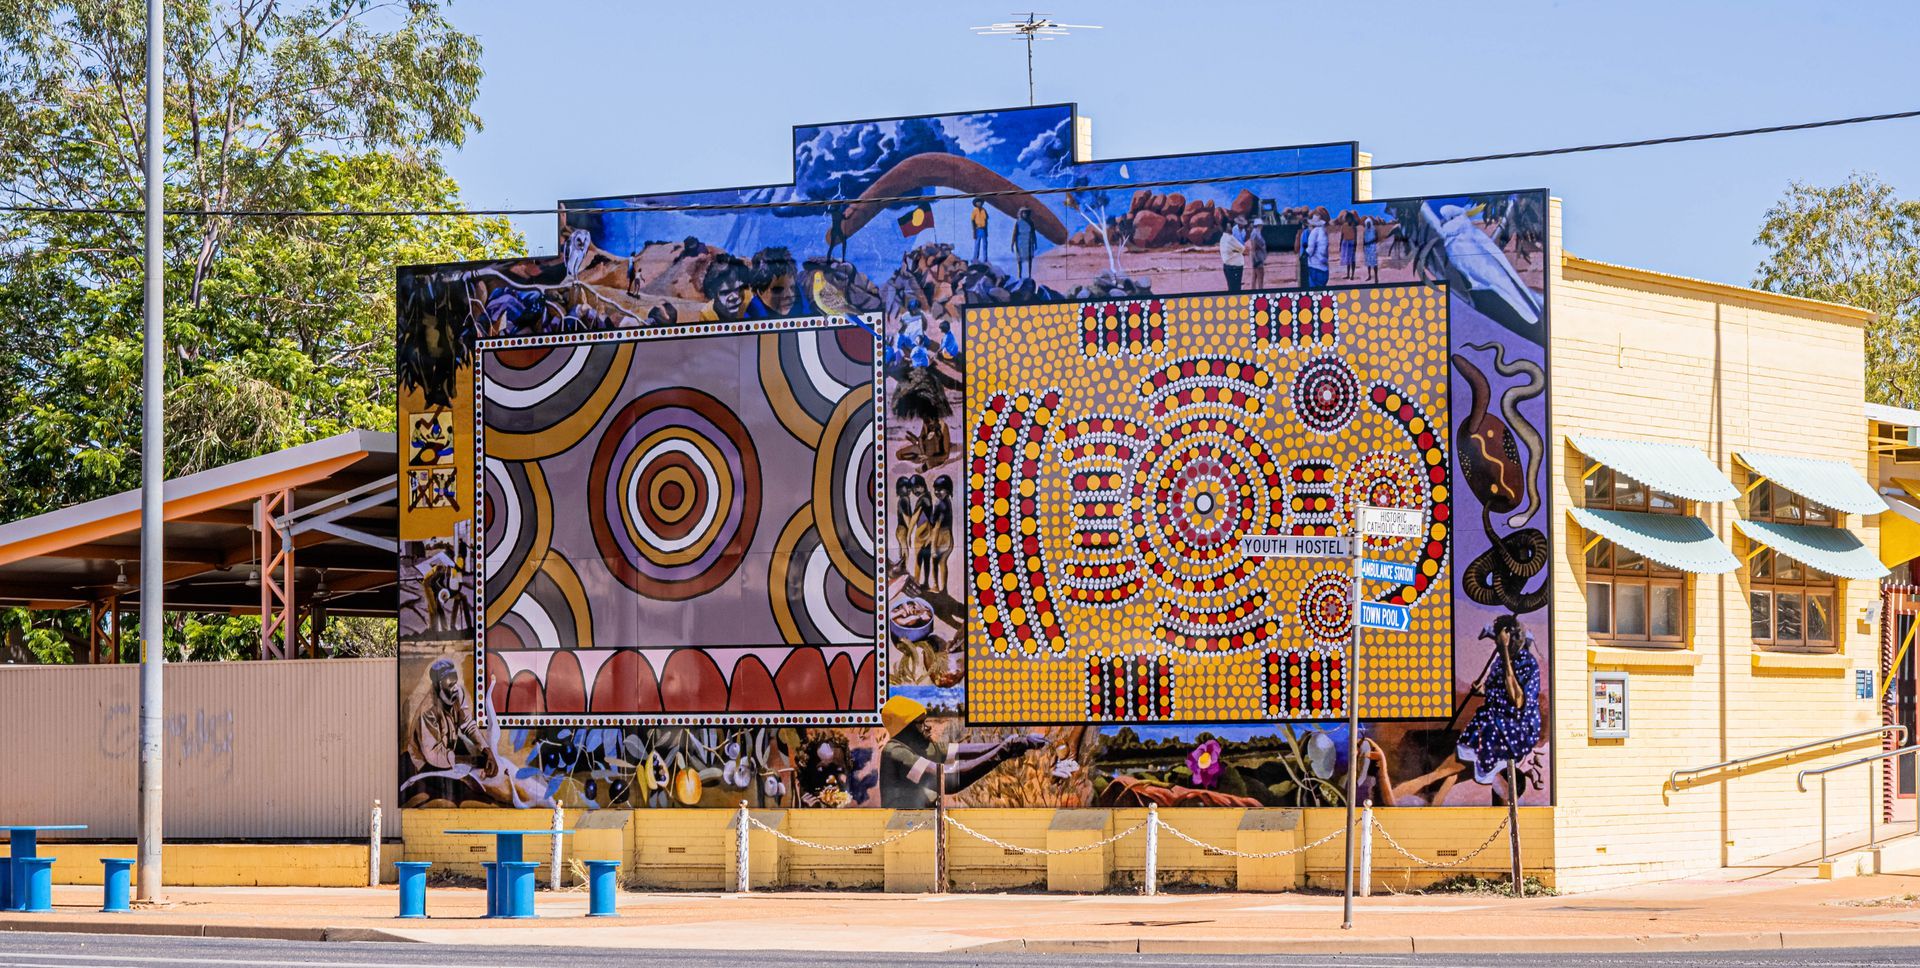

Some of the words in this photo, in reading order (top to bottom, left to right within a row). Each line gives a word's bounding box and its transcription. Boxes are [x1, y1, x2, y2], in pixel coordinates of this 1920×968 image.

[1380, 511, 1407, 523] HISTORIC
[1366, 521, 1396, 534] CATHOLIC
[1397, 523, 1421, 535] CHURCH
[1244, 539, 1287, 554] YOUTH
[1296, 539, 1344, 555] HOSTEL
[1361, 561, 1393, 580] AMBULANCE
[1394, 565, 1414, 582] STATION
[1362, 605, 1380, 624] TOWN
[1381, 607, 1400, 627] POOL
